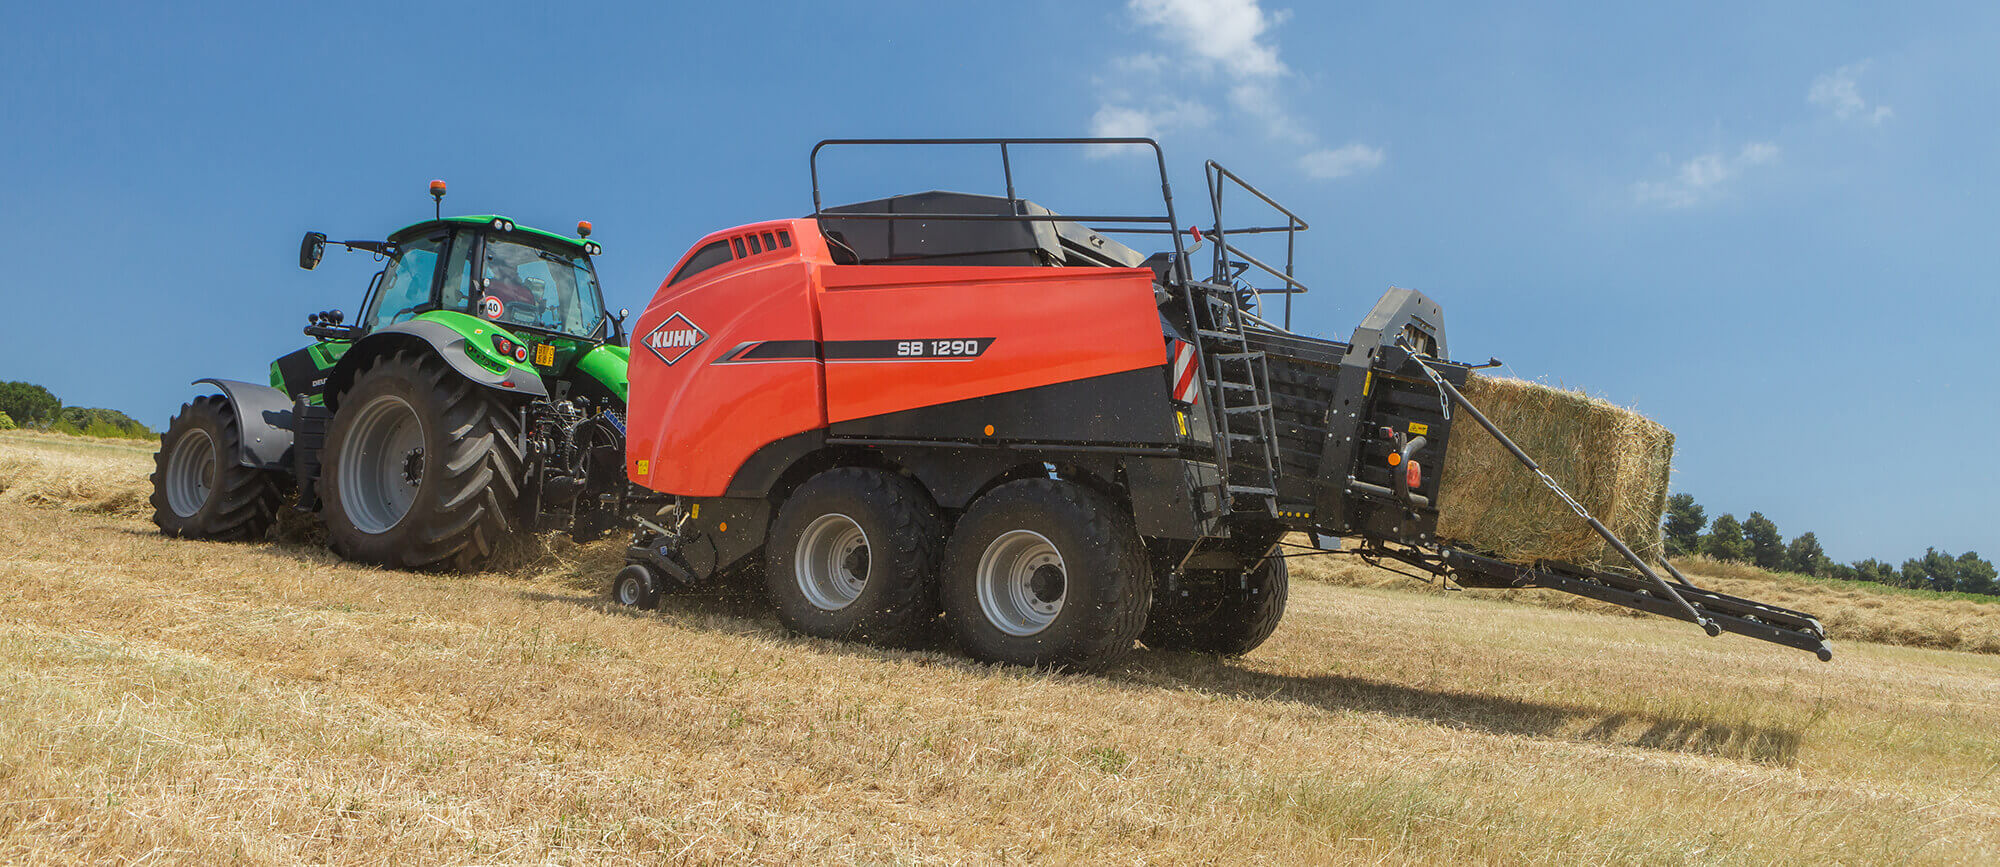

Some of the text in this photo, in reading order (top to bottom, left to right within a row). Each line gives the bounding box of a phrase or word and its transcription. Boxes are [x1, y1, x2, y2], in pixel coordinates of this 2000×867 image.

[488, 302, 499, 313] 40
[651, 329, 698, 349] KUHN
[897, 340, 978, 356] SB 1290
